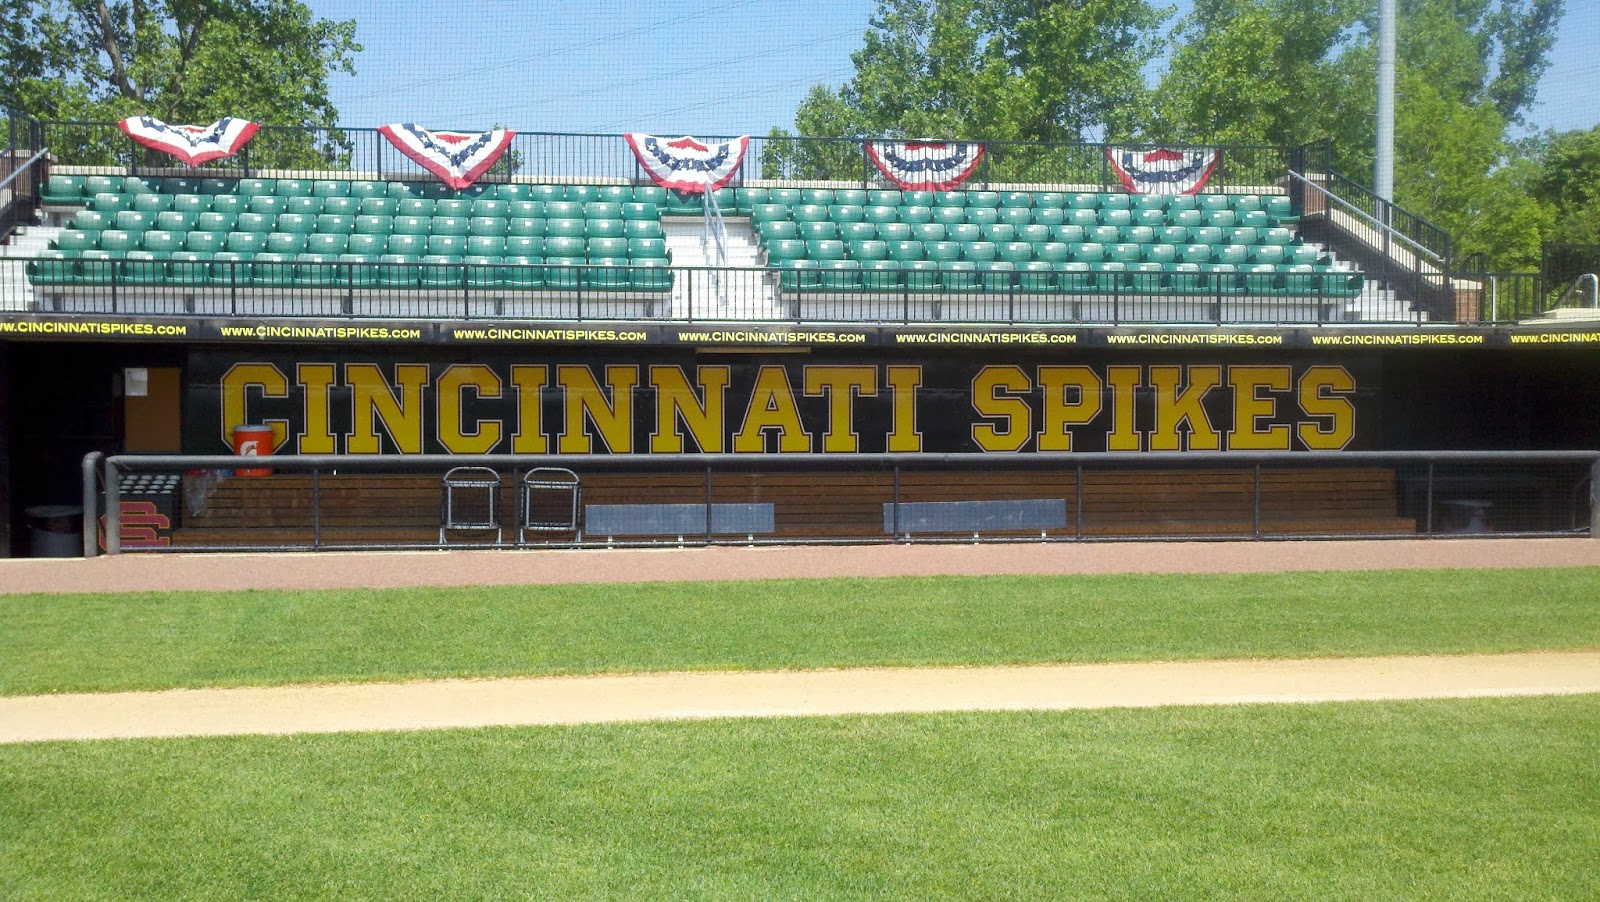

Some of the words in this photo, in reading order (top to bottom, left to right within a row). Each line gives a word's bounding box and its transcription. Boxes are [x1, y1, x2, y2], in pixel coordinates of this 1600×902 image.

[221, 325, 420, 340] WWW.CINCINNATISPIKES.COM
[454, 328, 647, 341] WWW.CINCINNATISPIKES.COM
[678, 330, 865, 343] WWW.CINCINNATISPIKES.COM
[896, 332, 1077, 344] WWW.CINCINNATISPIKES.COM
[1107, 333, 1282, 345] WWW.CINCINNATISPIKES.COM
[1312, 333, 1483, 345] WWW.CINCINNATISPIKES.COM
[220, 362, 923, 455] CINCINNATI
[970, 364, 1357, 453] SPIKES
